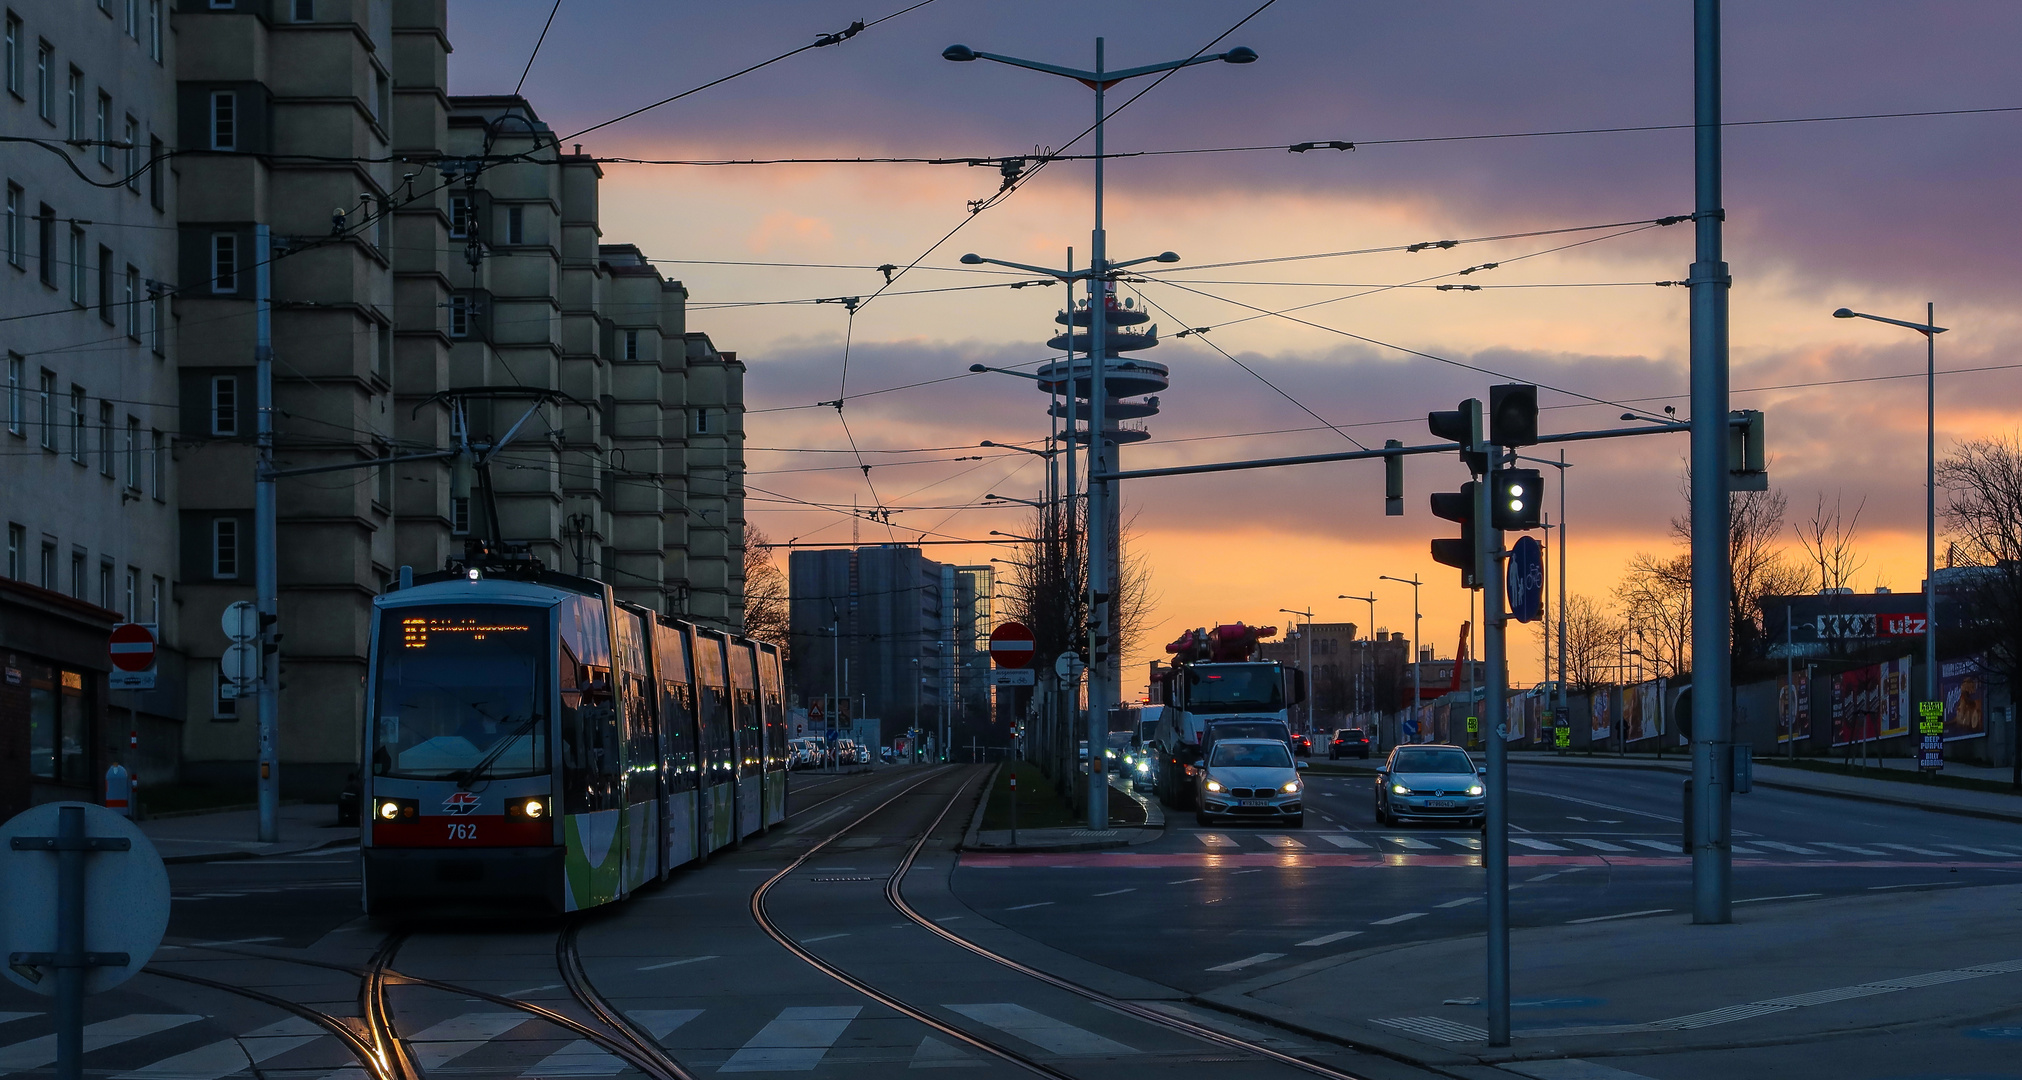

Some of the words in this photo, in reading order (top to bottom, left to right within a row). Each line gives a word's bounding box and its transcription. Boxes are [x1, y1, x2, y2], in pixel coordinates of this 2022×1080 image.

[1924, 735, 1940, 743] DEEP
[1920, 742, 1943, 750] PURPLE
[447, 823, 477, 840] 762
